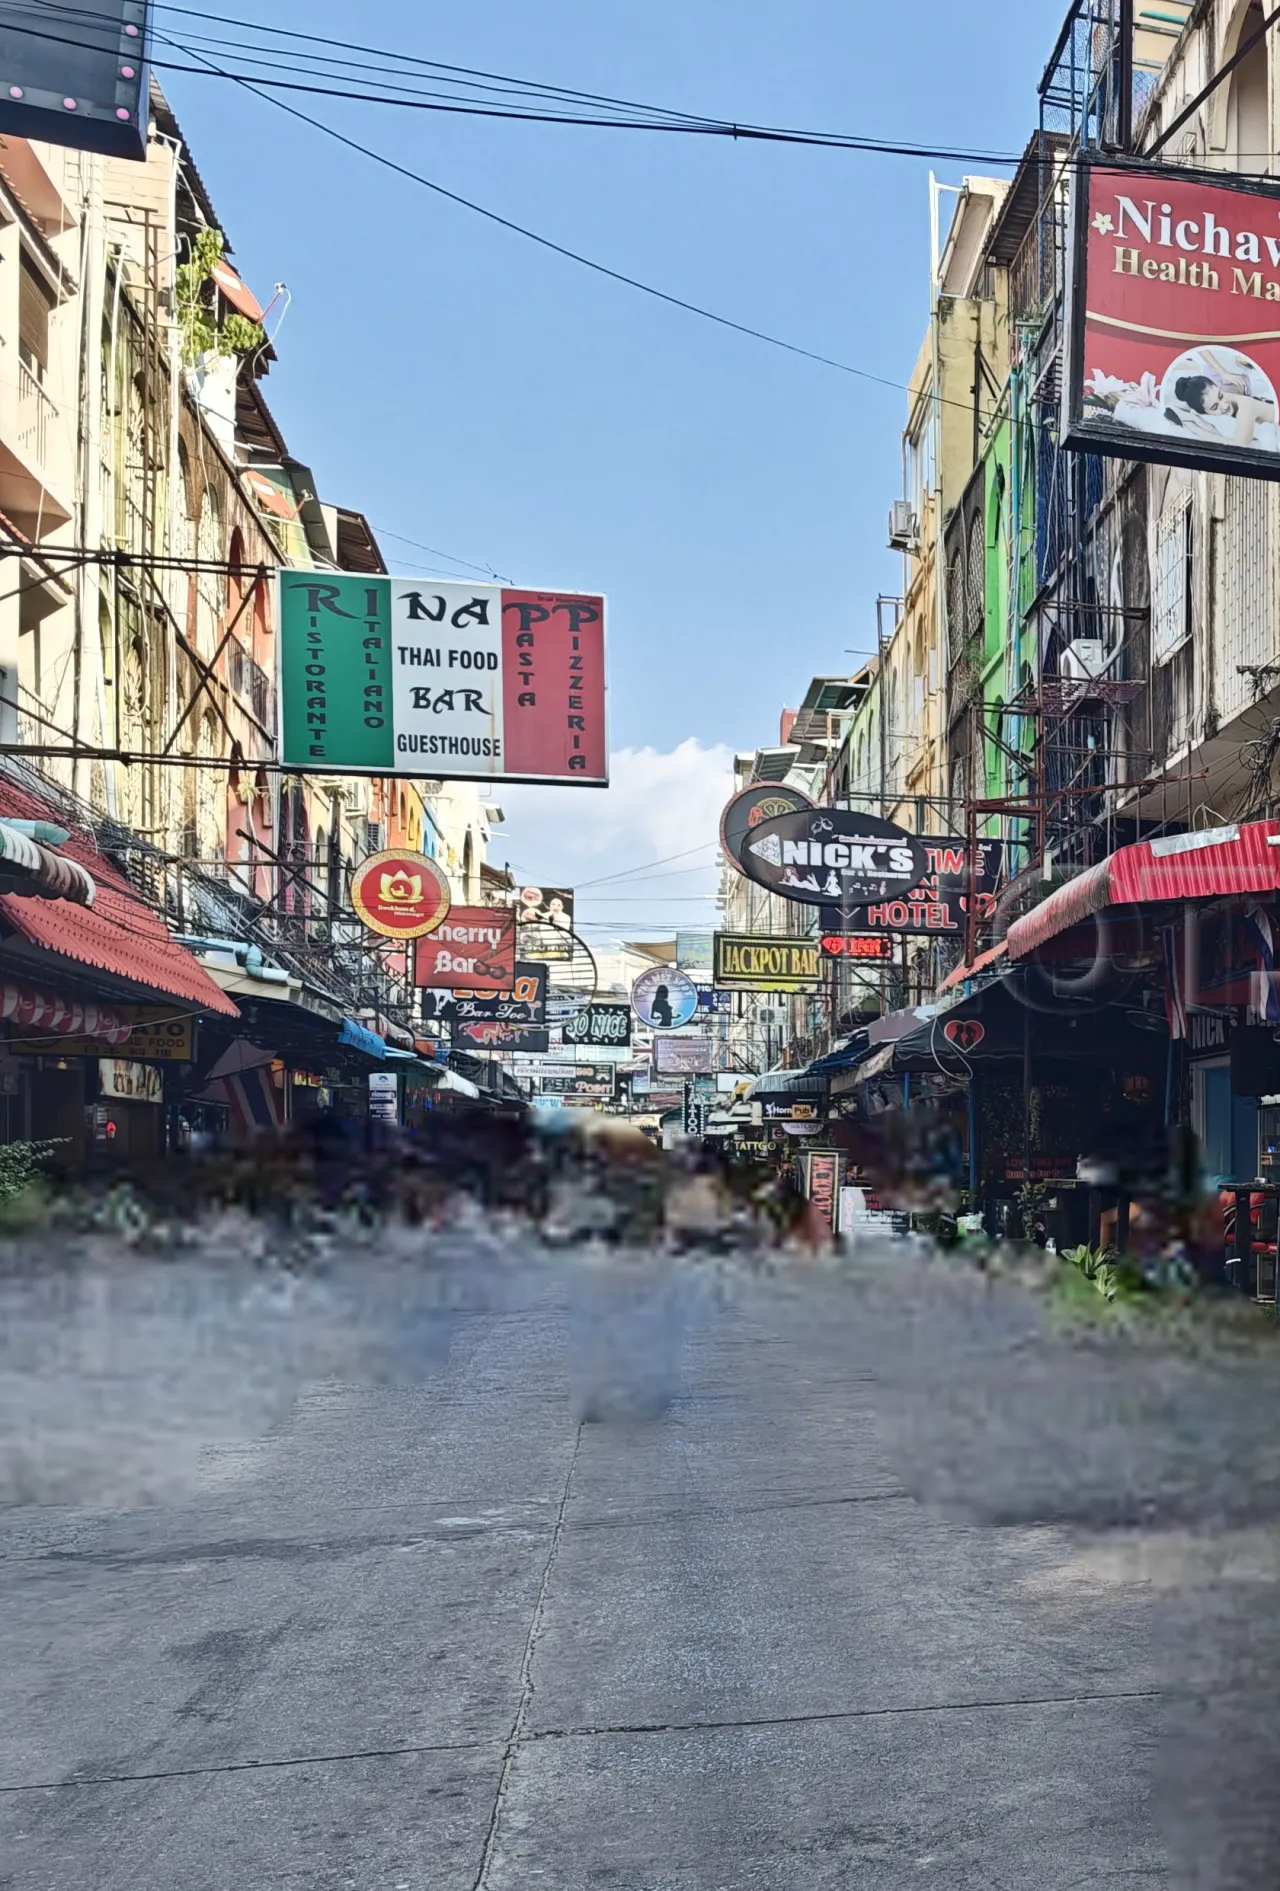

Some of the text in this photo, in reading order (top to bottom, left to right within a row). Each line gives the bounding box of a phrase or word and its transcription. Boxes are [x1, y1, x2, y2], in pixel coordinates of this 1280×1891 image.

[1112, 245, 1220, 291] Health
[362, 588, 385, 729] ITALIANO
[397, 646, 499, 671] THAI FOOD
[502, 602, 550, 707] PASTA
[408, 686, 495, 716] BAR
[551, 603, 600, 771] PIZZERIA
[396, 733, 501, 757] GUESTHOUSE
[868, 900, 959, 929] HOTEL
[434, 950, 478, 974] Bar
[723, 945, 819, 975] JACKPOT BAR
[590, 1014, 628, 1039] NICE
[149, 1037, 185, 1048] FOOD
